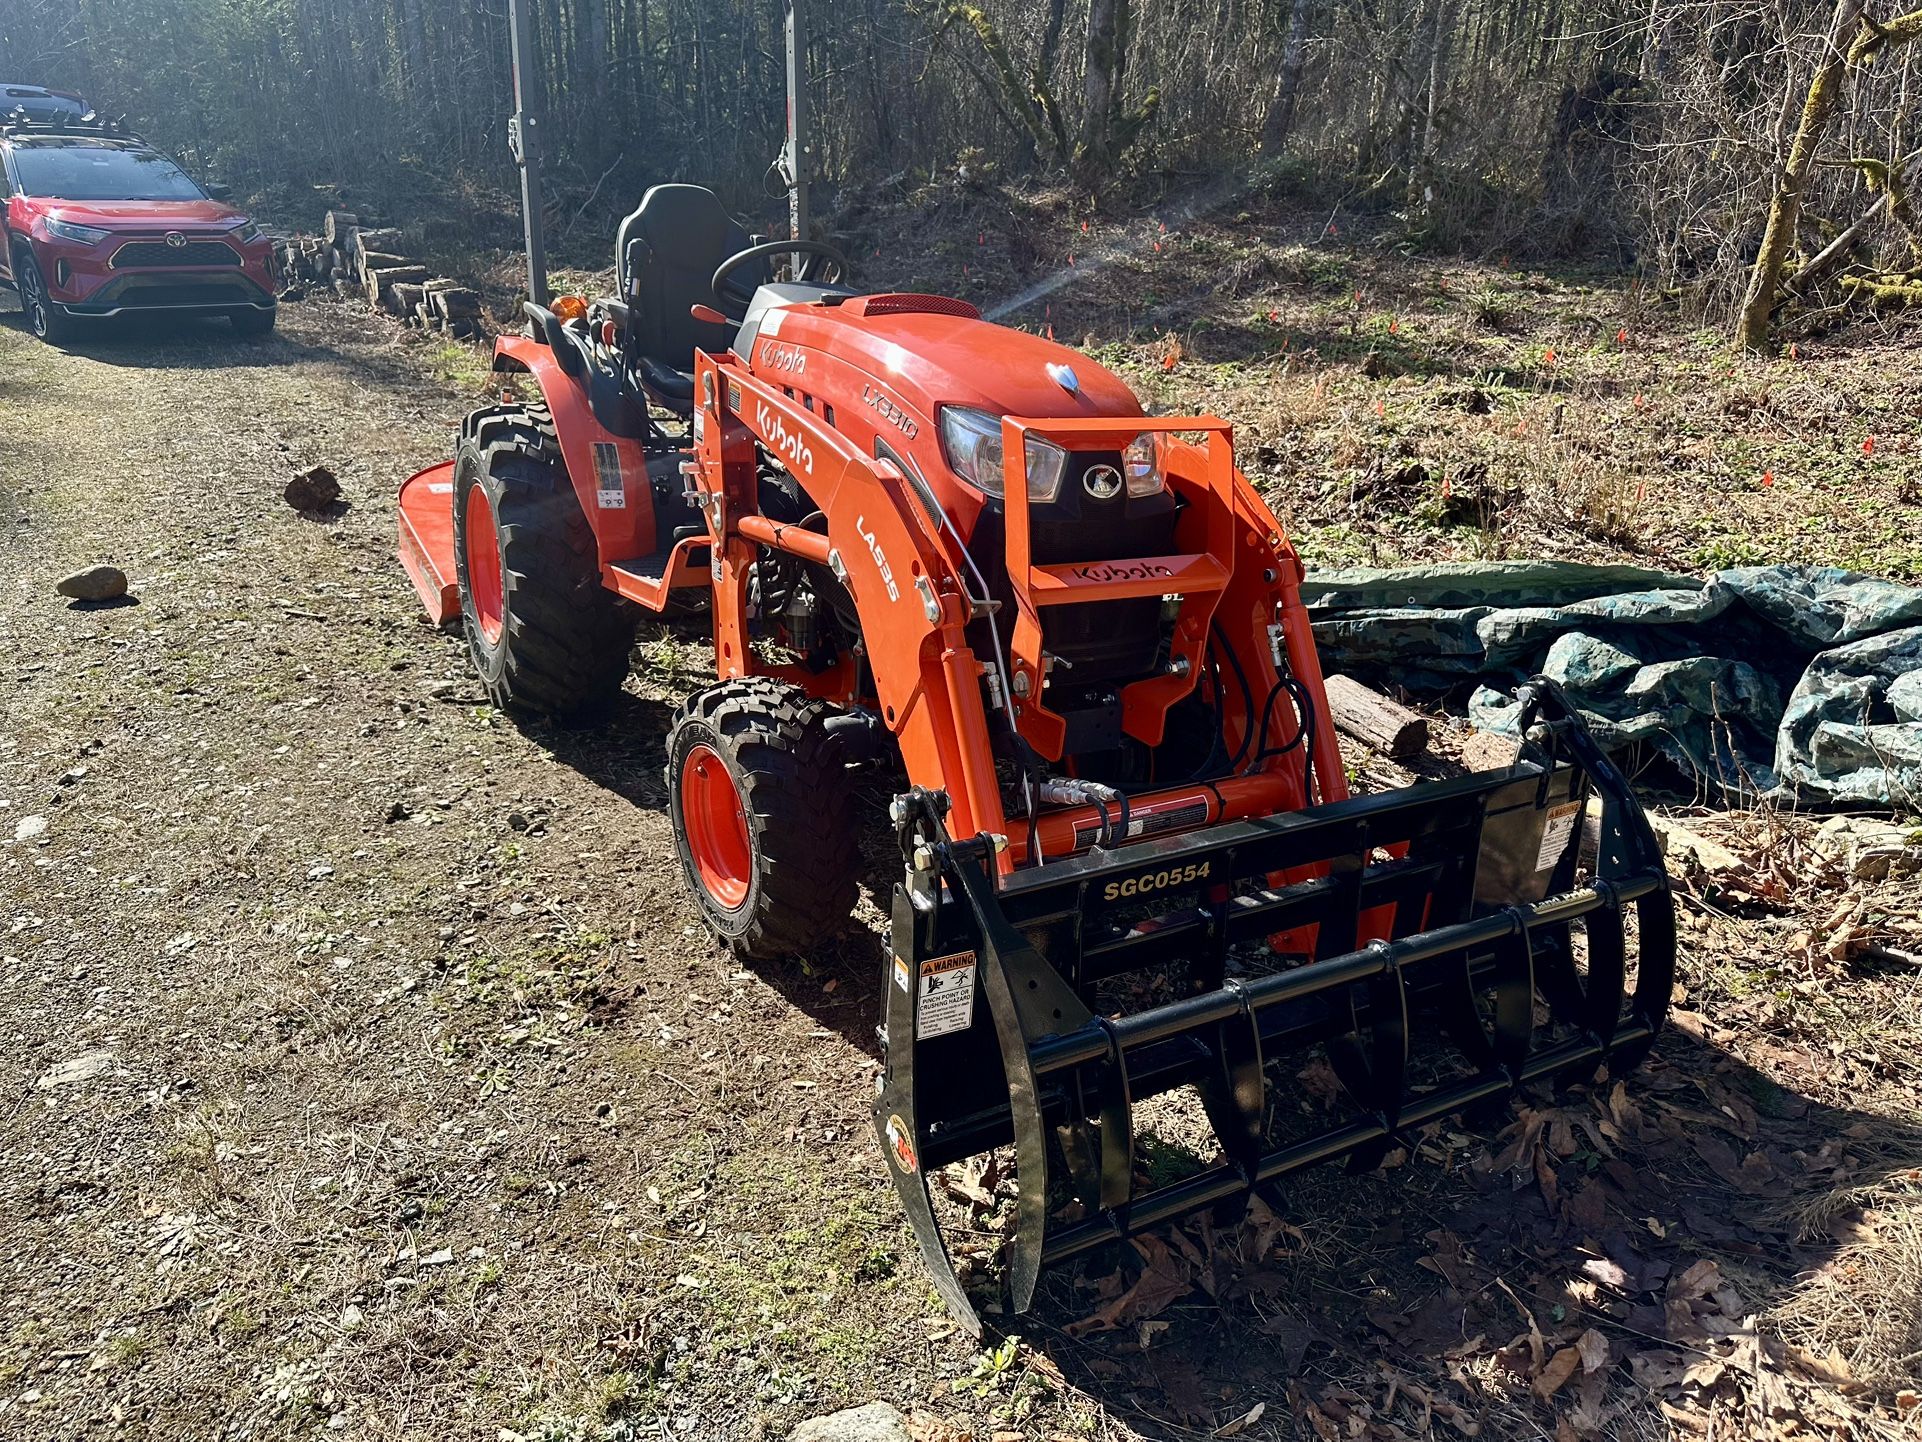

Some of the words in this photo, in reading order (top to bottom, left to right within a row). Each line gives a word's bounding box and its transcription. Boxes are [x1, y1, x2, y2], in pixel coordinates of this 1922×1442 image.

[758, 341, 807, 375] Kubota
[862, 383, 919, 441] LX3310
[756, 400, 814, 475] Kubota
[856, 514, 900, 602] LA535
[1071, 562, 1174, 582] Kubota
[1103, 861, 1211, 901] SGC0554
[934, 954, 974, 971] WARNING
[920, 1000, 948, 1011] CRUSHING
[948, 995, 971, 1004] HAZARD
[922, 995, 941, 1004] PINCH
[941, 991, 960, 1000] POINT
